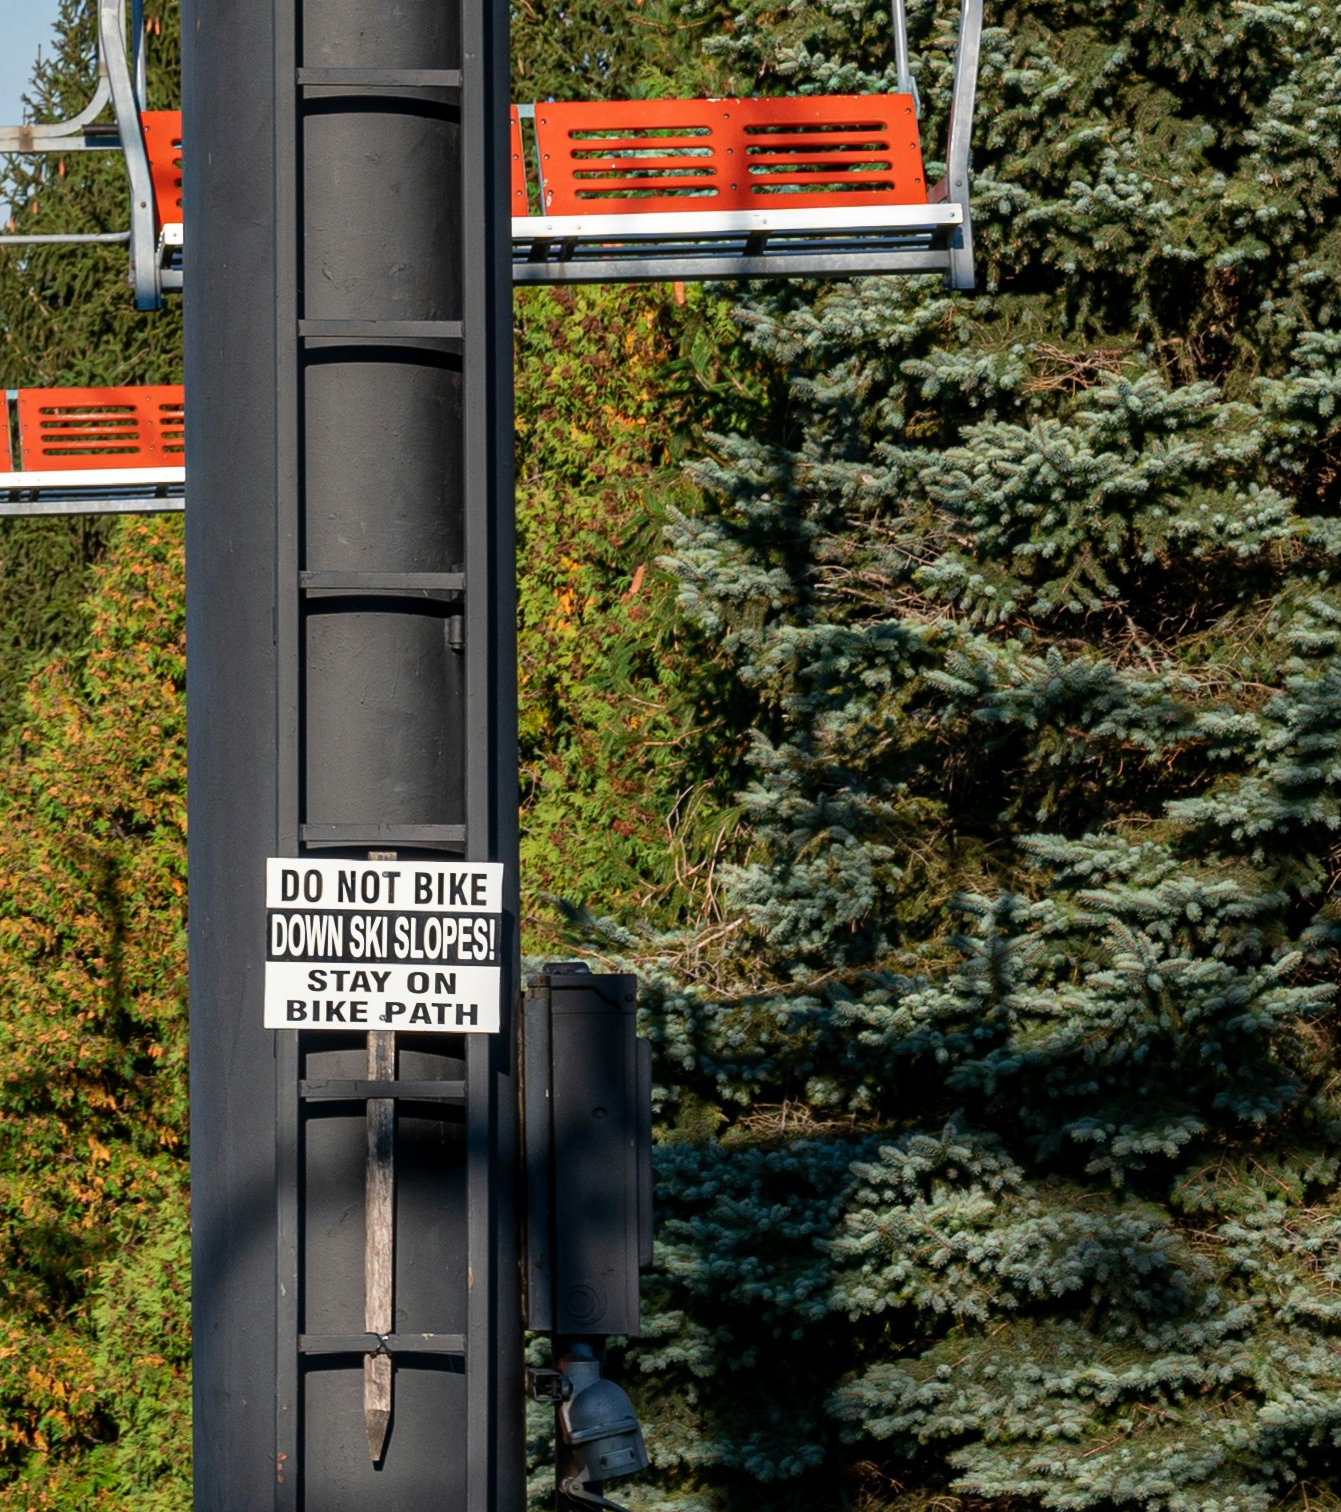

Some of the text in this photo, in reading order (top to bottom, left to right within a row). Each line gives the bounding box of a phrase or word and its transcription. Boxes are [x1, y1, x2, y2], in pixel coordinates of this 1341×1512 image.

[281, 868, 487, 907] DO NOT BIKE
[271, 913, 496, 961] DOWN SKI SLOPES!
[307, 969, 456, 995] STAY ON
[286, 999, 478, 1026] BIKE PATH
